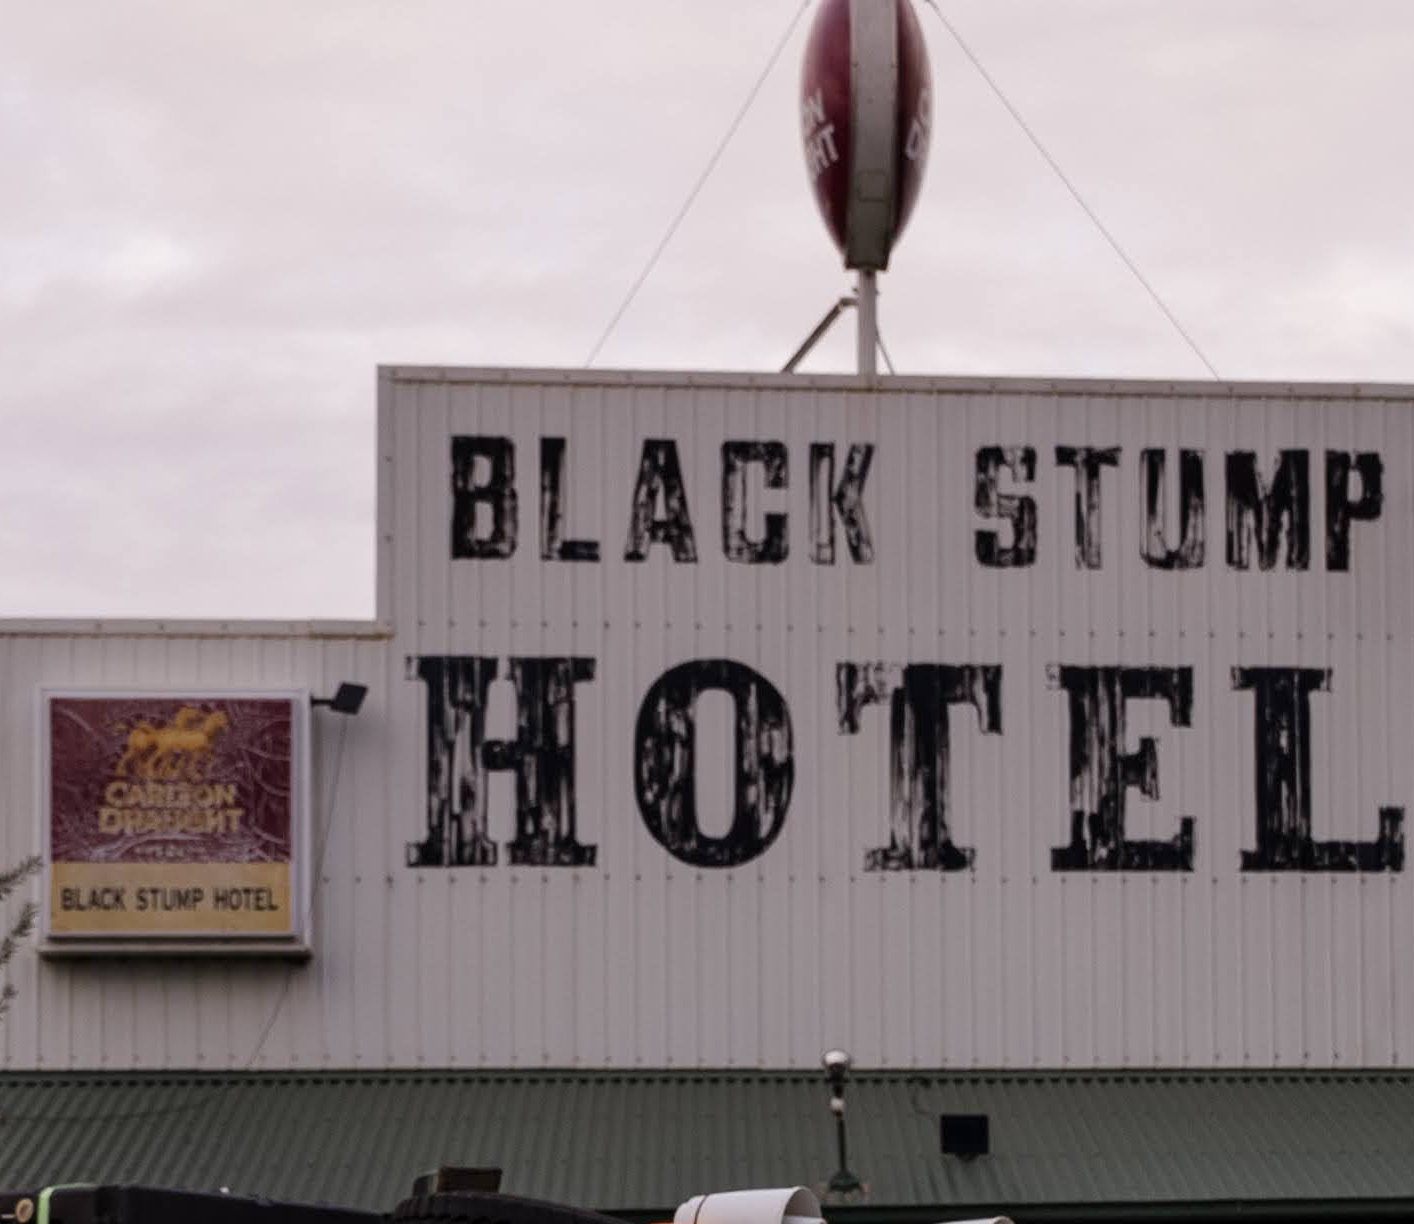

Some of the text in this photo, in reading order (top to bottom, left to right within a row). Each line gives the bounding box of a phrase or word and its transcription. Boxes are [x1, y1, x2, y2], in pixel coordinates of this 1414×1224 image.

[450, 436, 1384, 571] BLACK STUMP
[405, 656, 1406, 872] HOTEL
[60, 887, 279, 912] BLACK STUMP HOTEL
